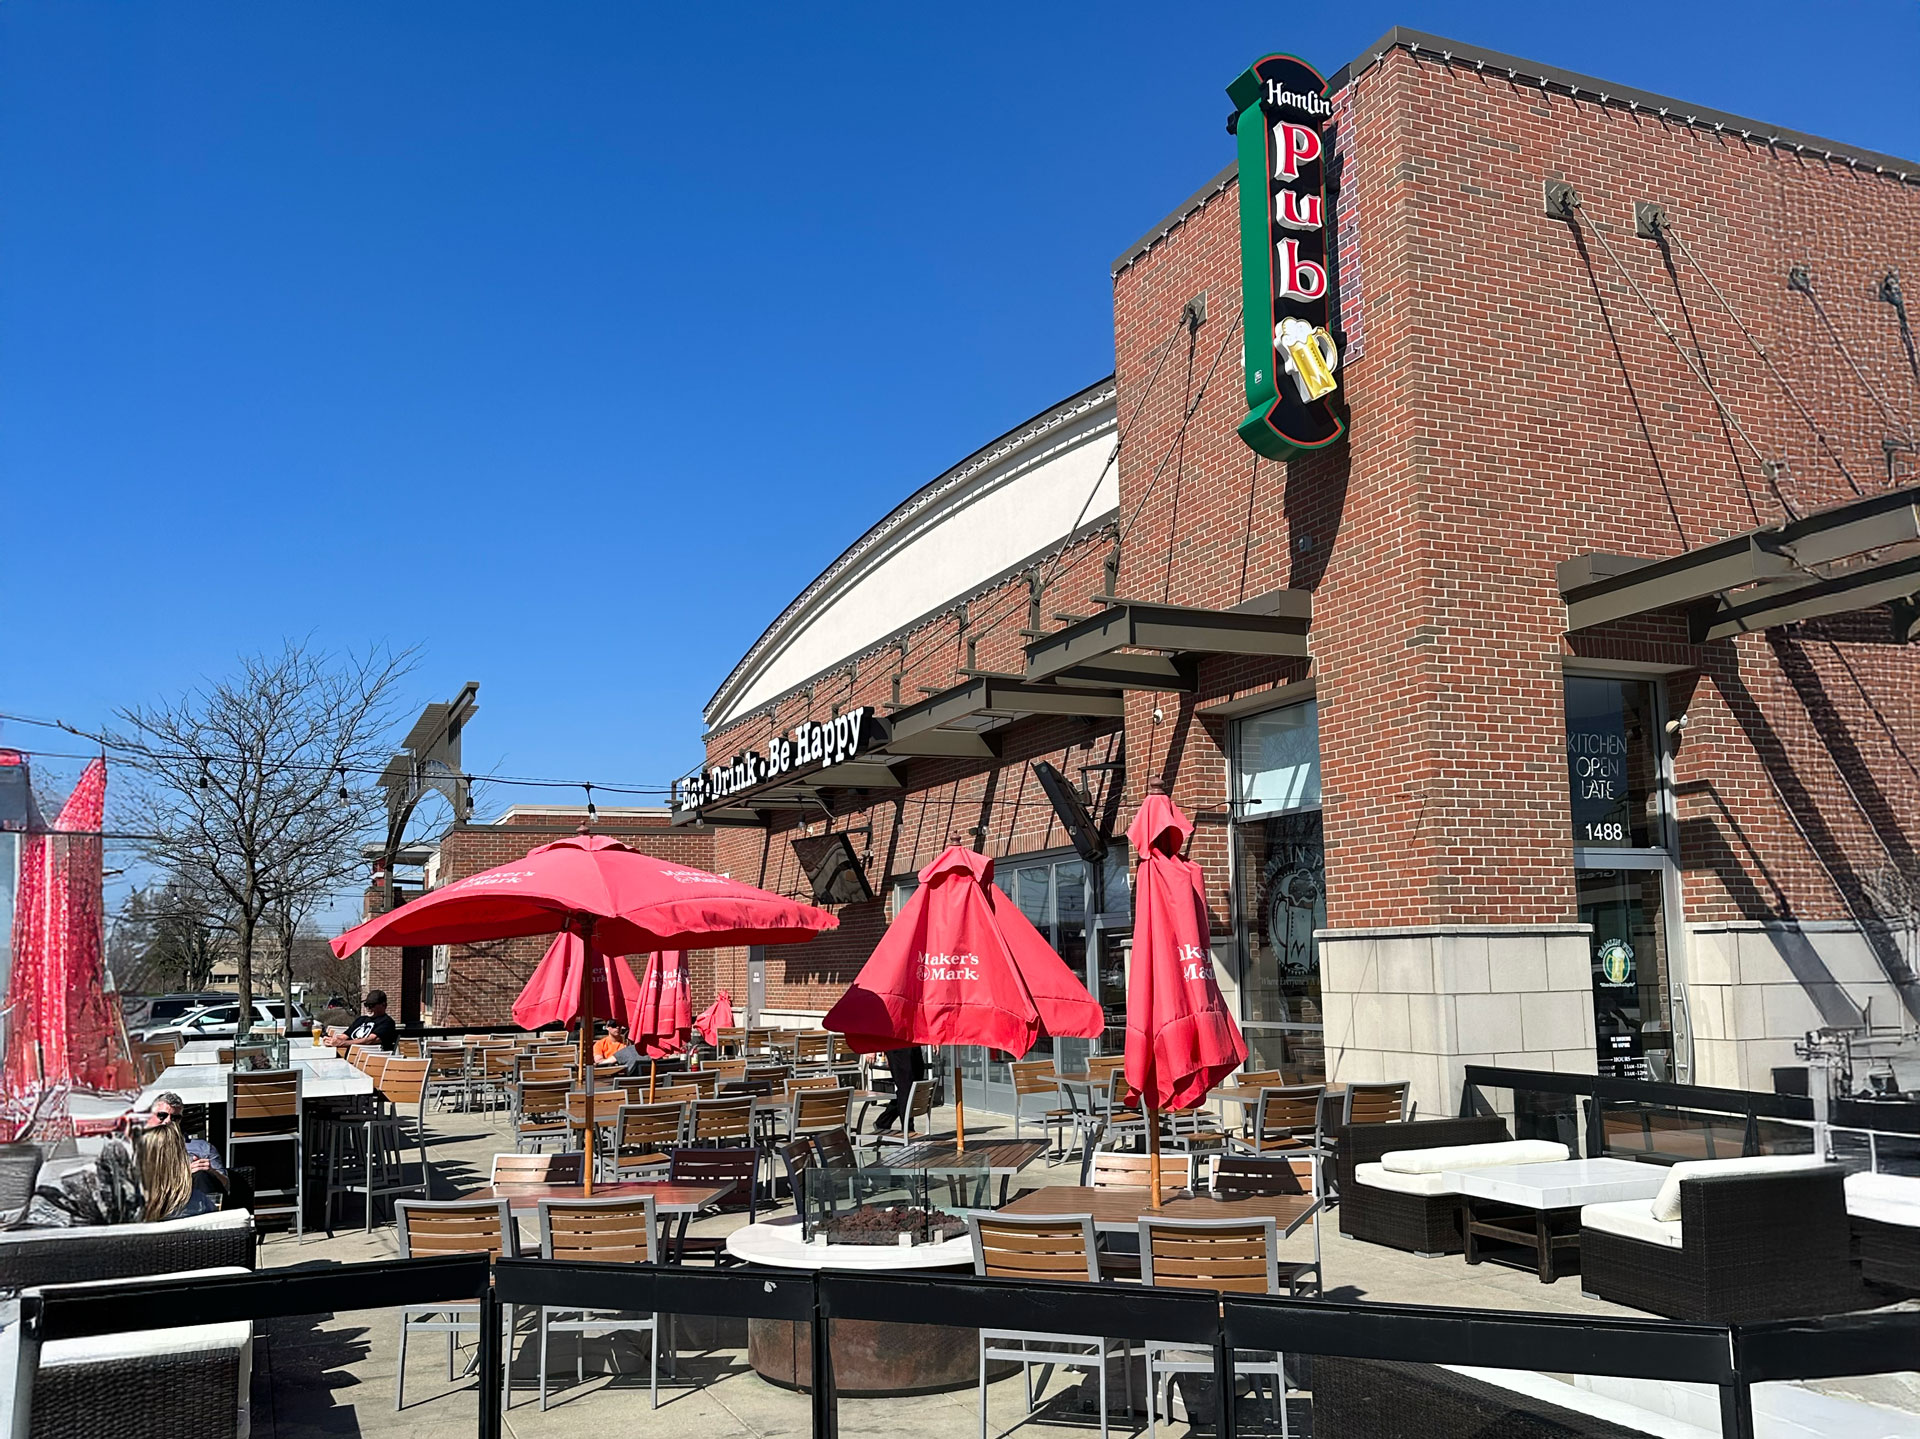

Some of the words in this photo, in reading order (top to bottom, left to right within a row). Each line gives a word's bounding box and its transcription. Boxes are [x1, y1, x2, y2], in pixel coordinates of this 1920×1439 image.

[1266, 78, 1333, 116] Hamlin
[1273, 120, 1327, 303] Pub
[1567, 733, 1627, 755] KITCHEN
[681, 773, 705, 811] Eat
[711, 751, 757, 800] Drink
[768, 737, 790, 777] Be
[794, 706, 864, 768] Happy
[1576, 756, 1618, 777] OPEN
[1581, 779, 1614, 800] LATE
[1585, 823, 1623, 840] 1488
[917, 951, 979, 966] Maker's
[931, 968, 979, 981] Mark
